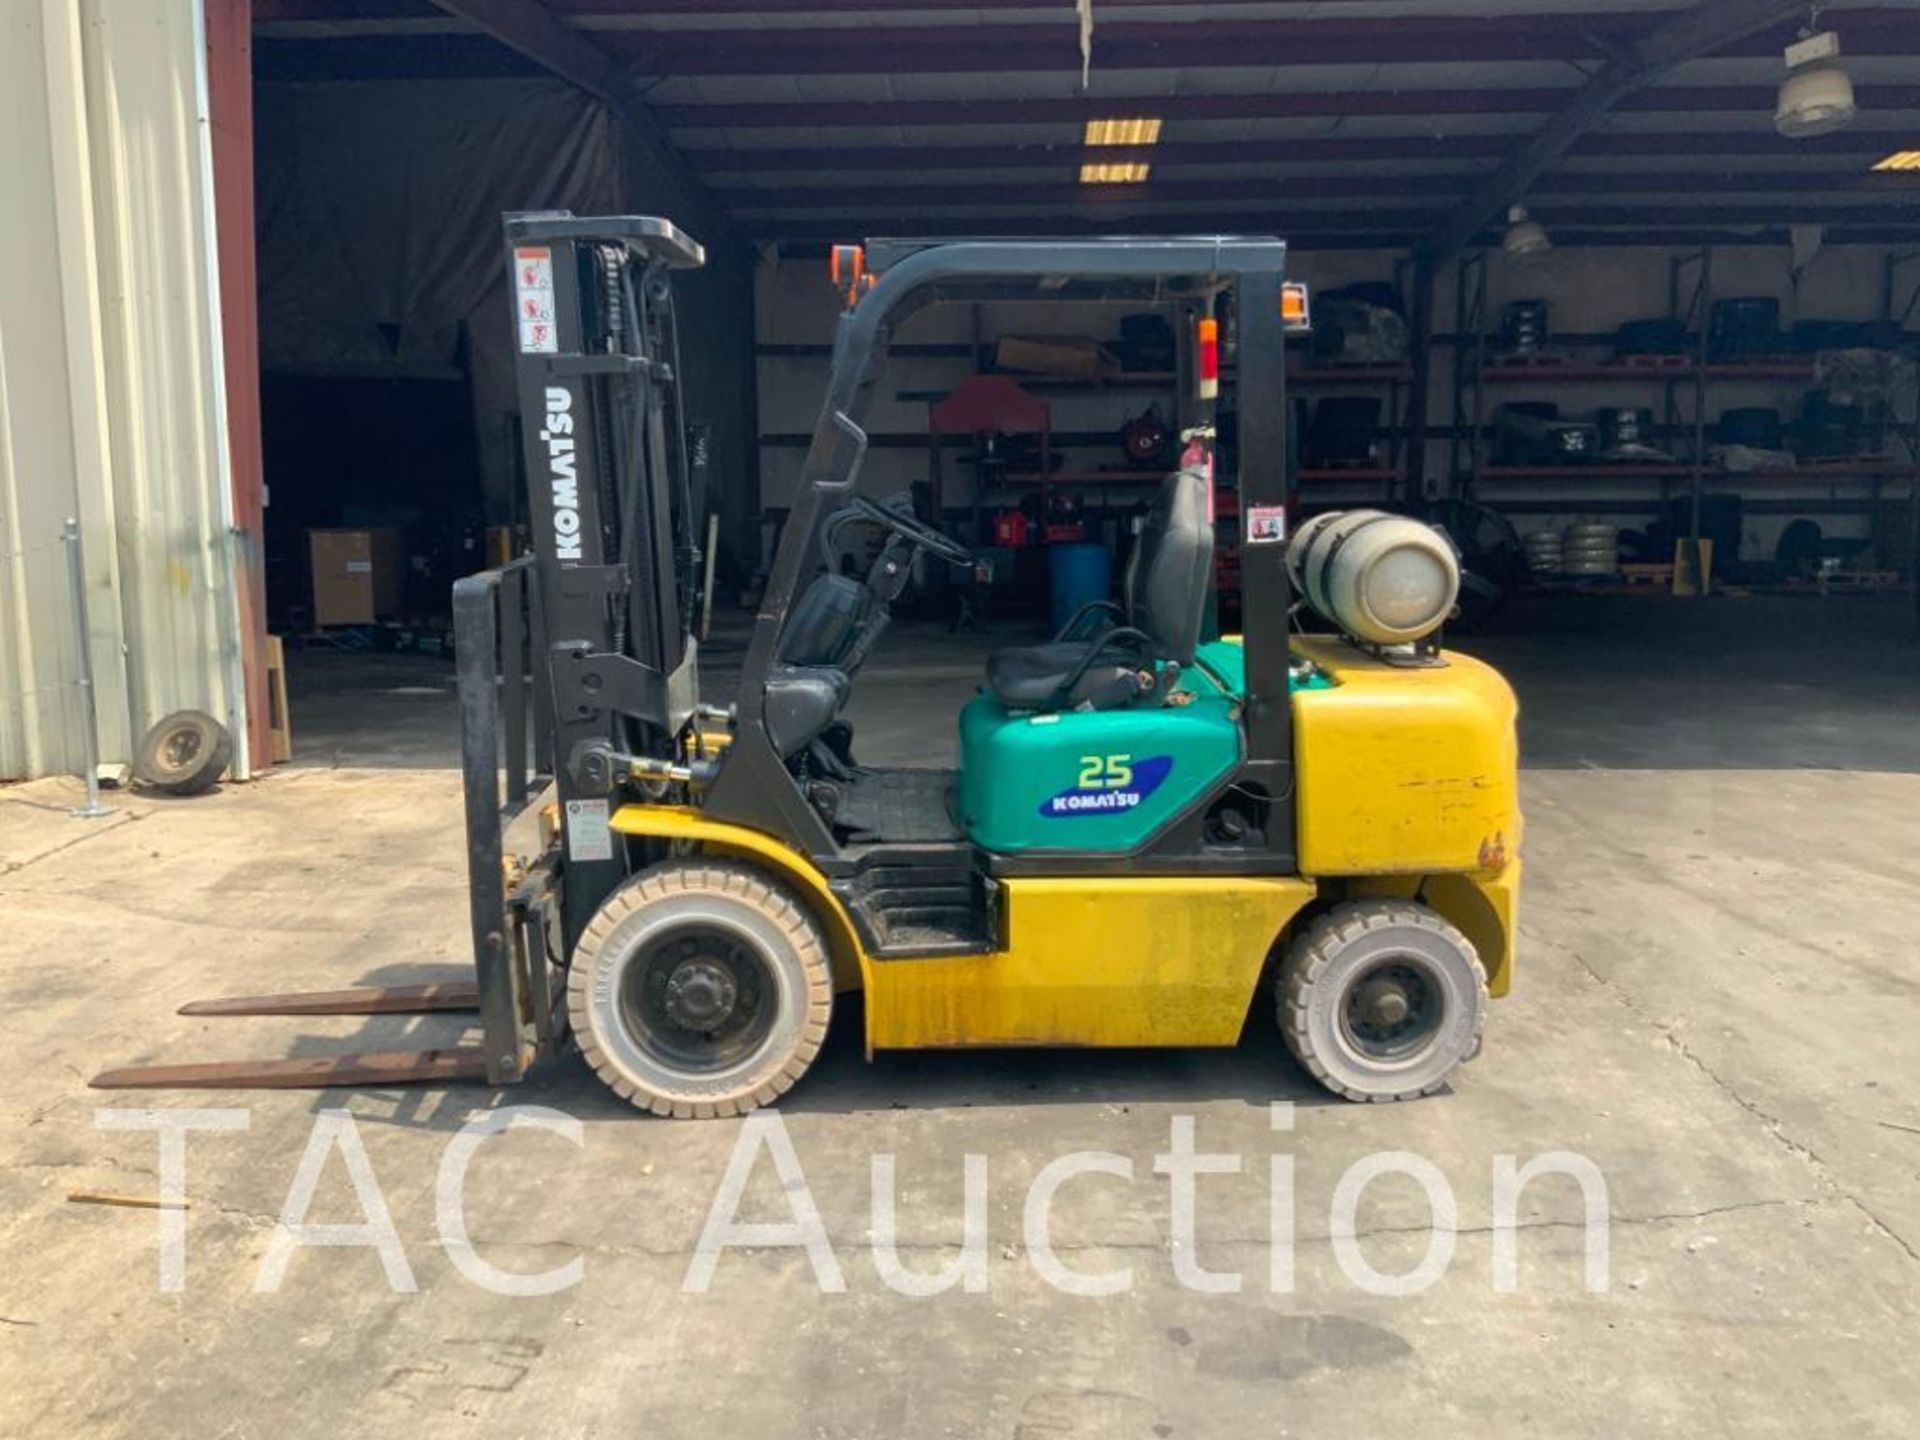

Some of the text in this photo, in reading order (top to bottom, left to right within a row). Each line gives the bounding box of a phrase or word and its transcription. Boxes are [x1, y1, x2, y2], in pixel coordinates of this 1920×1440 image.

[540, 387, 582, 560] KOMATSU
[1078, 754, 1133, 789] 25
[1053, 791, 1140, 811] KOMATSU
